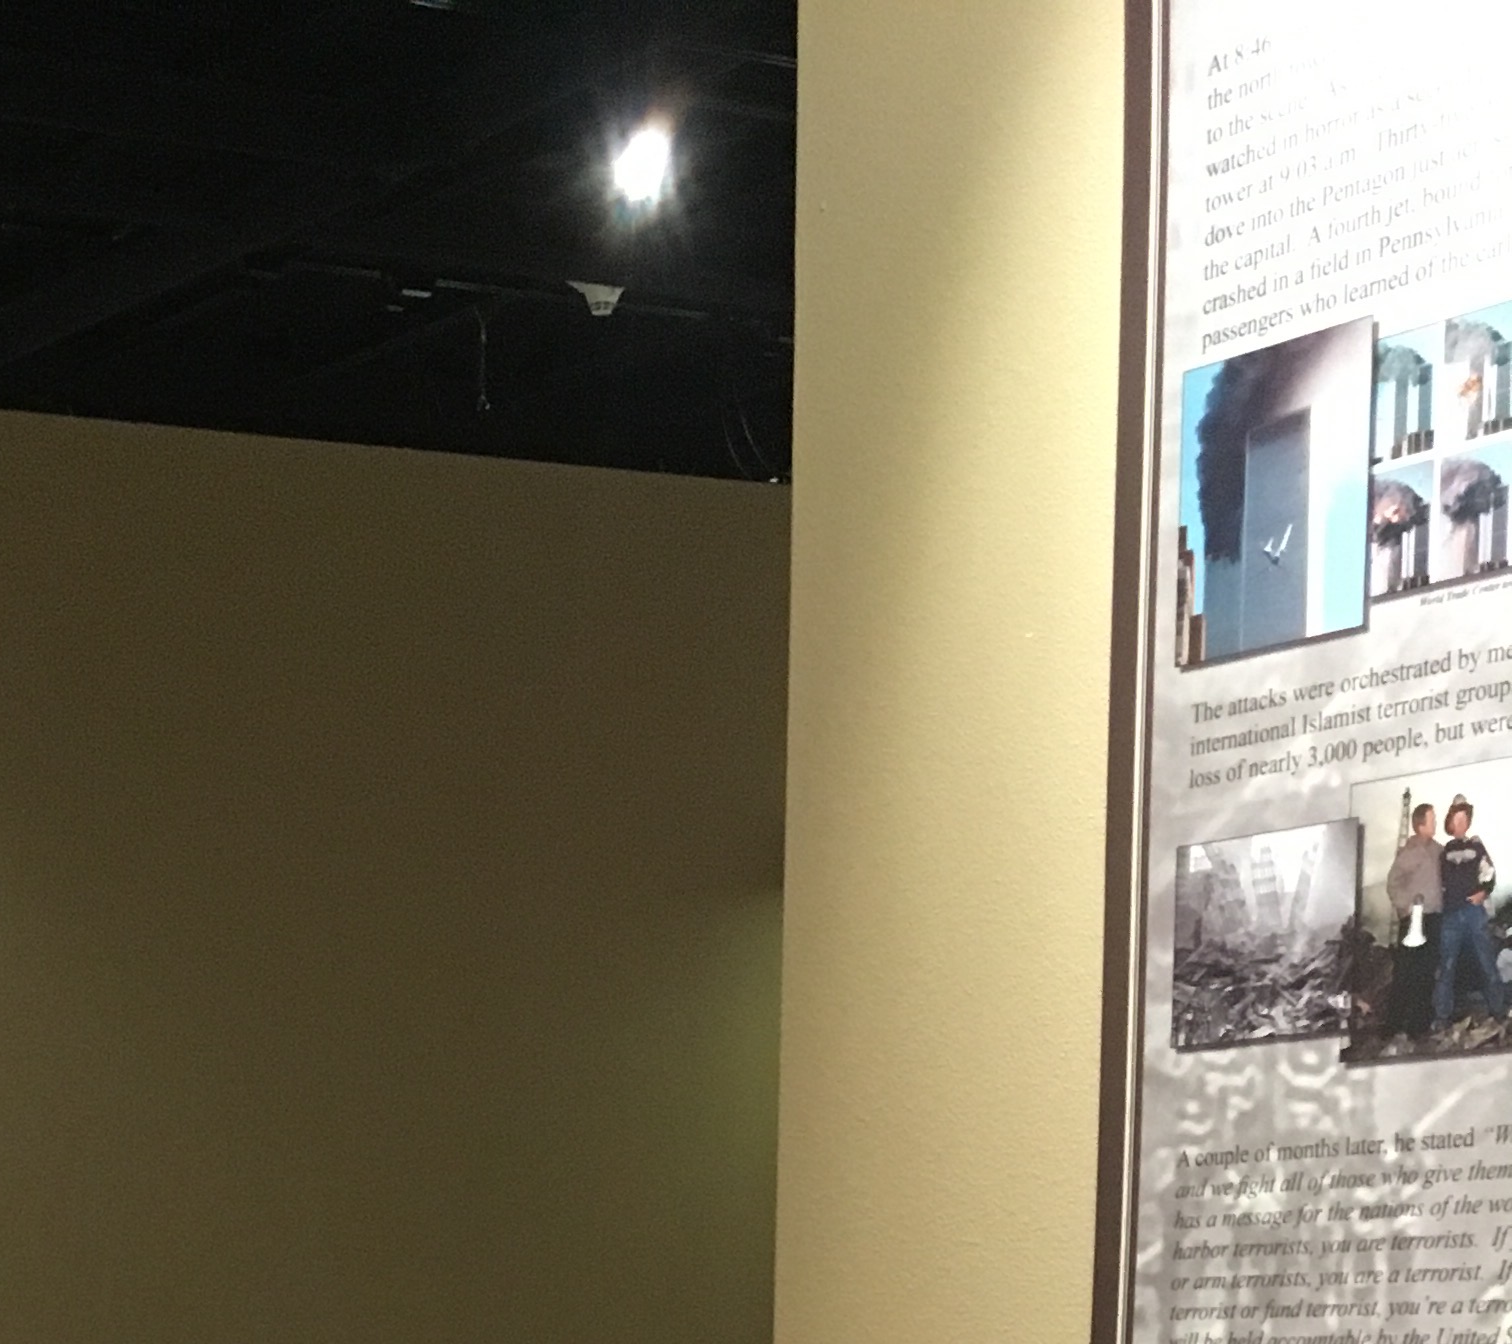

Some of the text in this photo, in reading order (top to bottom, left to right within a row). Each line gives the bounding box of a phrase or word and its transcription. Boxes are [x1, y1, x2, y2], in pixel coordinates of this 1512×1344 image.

[1207, 88, 1233, 110] the
[1206, 126, 1223, 145] to
[1229, 114, 1254, 136] the
[1206, 136, 1276, 177] watched
[1204, 220, 1245, 246] dove
[1251, 208, 1284, 231] into
[1290, 196, 1316, 218] the
[1322, 166, 1405, 207] Pentagon
[1205, 183, 1253, 213] tower
[1258, 175, 1274, 195] at
[1203, 259, 1229, 281] the
[1308, 226, 1321, 246] A
[1328, 205, 1381, 240] fourth
[1202, 275, 1267, 315] crashed
[1273, 272, 1289, 292] in
[1294, 270, 1304, 286] a
[1311, 249, 1348, 279] field
[1356, 246, 1371, 265] in
[1202, 308, 1293, 354] passengers
[1300, 292, 1337, 316] who
[1344, 265, 1409, 304] learned
[1415, 256, 1438, 282] of
[1192, 701, 1224, 724] The
[1228, 688, 1287, 717] attacks
[1293, 680, 1335, 702] were
[1340, 651, 1452, 693] orchestrated
[1458, 648, 1481, 673] by
[1190, 679, 1511, 757] international Islamist terrorist group
[1189, 714, 1512, 789] loss of nearly 3,000 people, but were
[1177, 1150, 1190, 1168] A
[1195, 1144, 1249, 1170] couple
[1254, 1141, 1275, 1163] of
[1277, 1138, 1339, 1161] months
[1394, 1132, 1416, 1152] he
[1420, 1126, 1475, 1150] stated
[1175, 1159, 1512, 1200] and we fight all of those who give them
[1174, 1210, 1200, 1229] has
[1206, 1214, 1217, 1228] a
[1222, 1209, 1292, 1230] message
[1293, 1203, 1323, 1229] for
[1327, 1201, 1354, 1223] the
[1358, 1202, 1425, 1221] nations
[1430, 1195, 1453, 1221] of
[1453, 1194, 1483, 1215] the
[1172, 1240, 1229, 1261] harbor
[1318, 1239, 1351, 1260] you
[1356, 1237, 1386, 1253] are
[1492, 1225, 1512, 1252] If
[1171, 1276, 1190, 1291] or
[1193, 1275, 1227, 1290] arm
[1315, 1272, 1348, 1291] you
[1354, 1269, 1384, 1284] are
[1388, 1268, 1400, 1283] a
[1170, 1303, 1237, 1321] terrorist
[1241, 1305, 1259, 1319] or
[1261, 1297, 1303, 1324] fund
[1450, 1300, 1464, 1315] a
